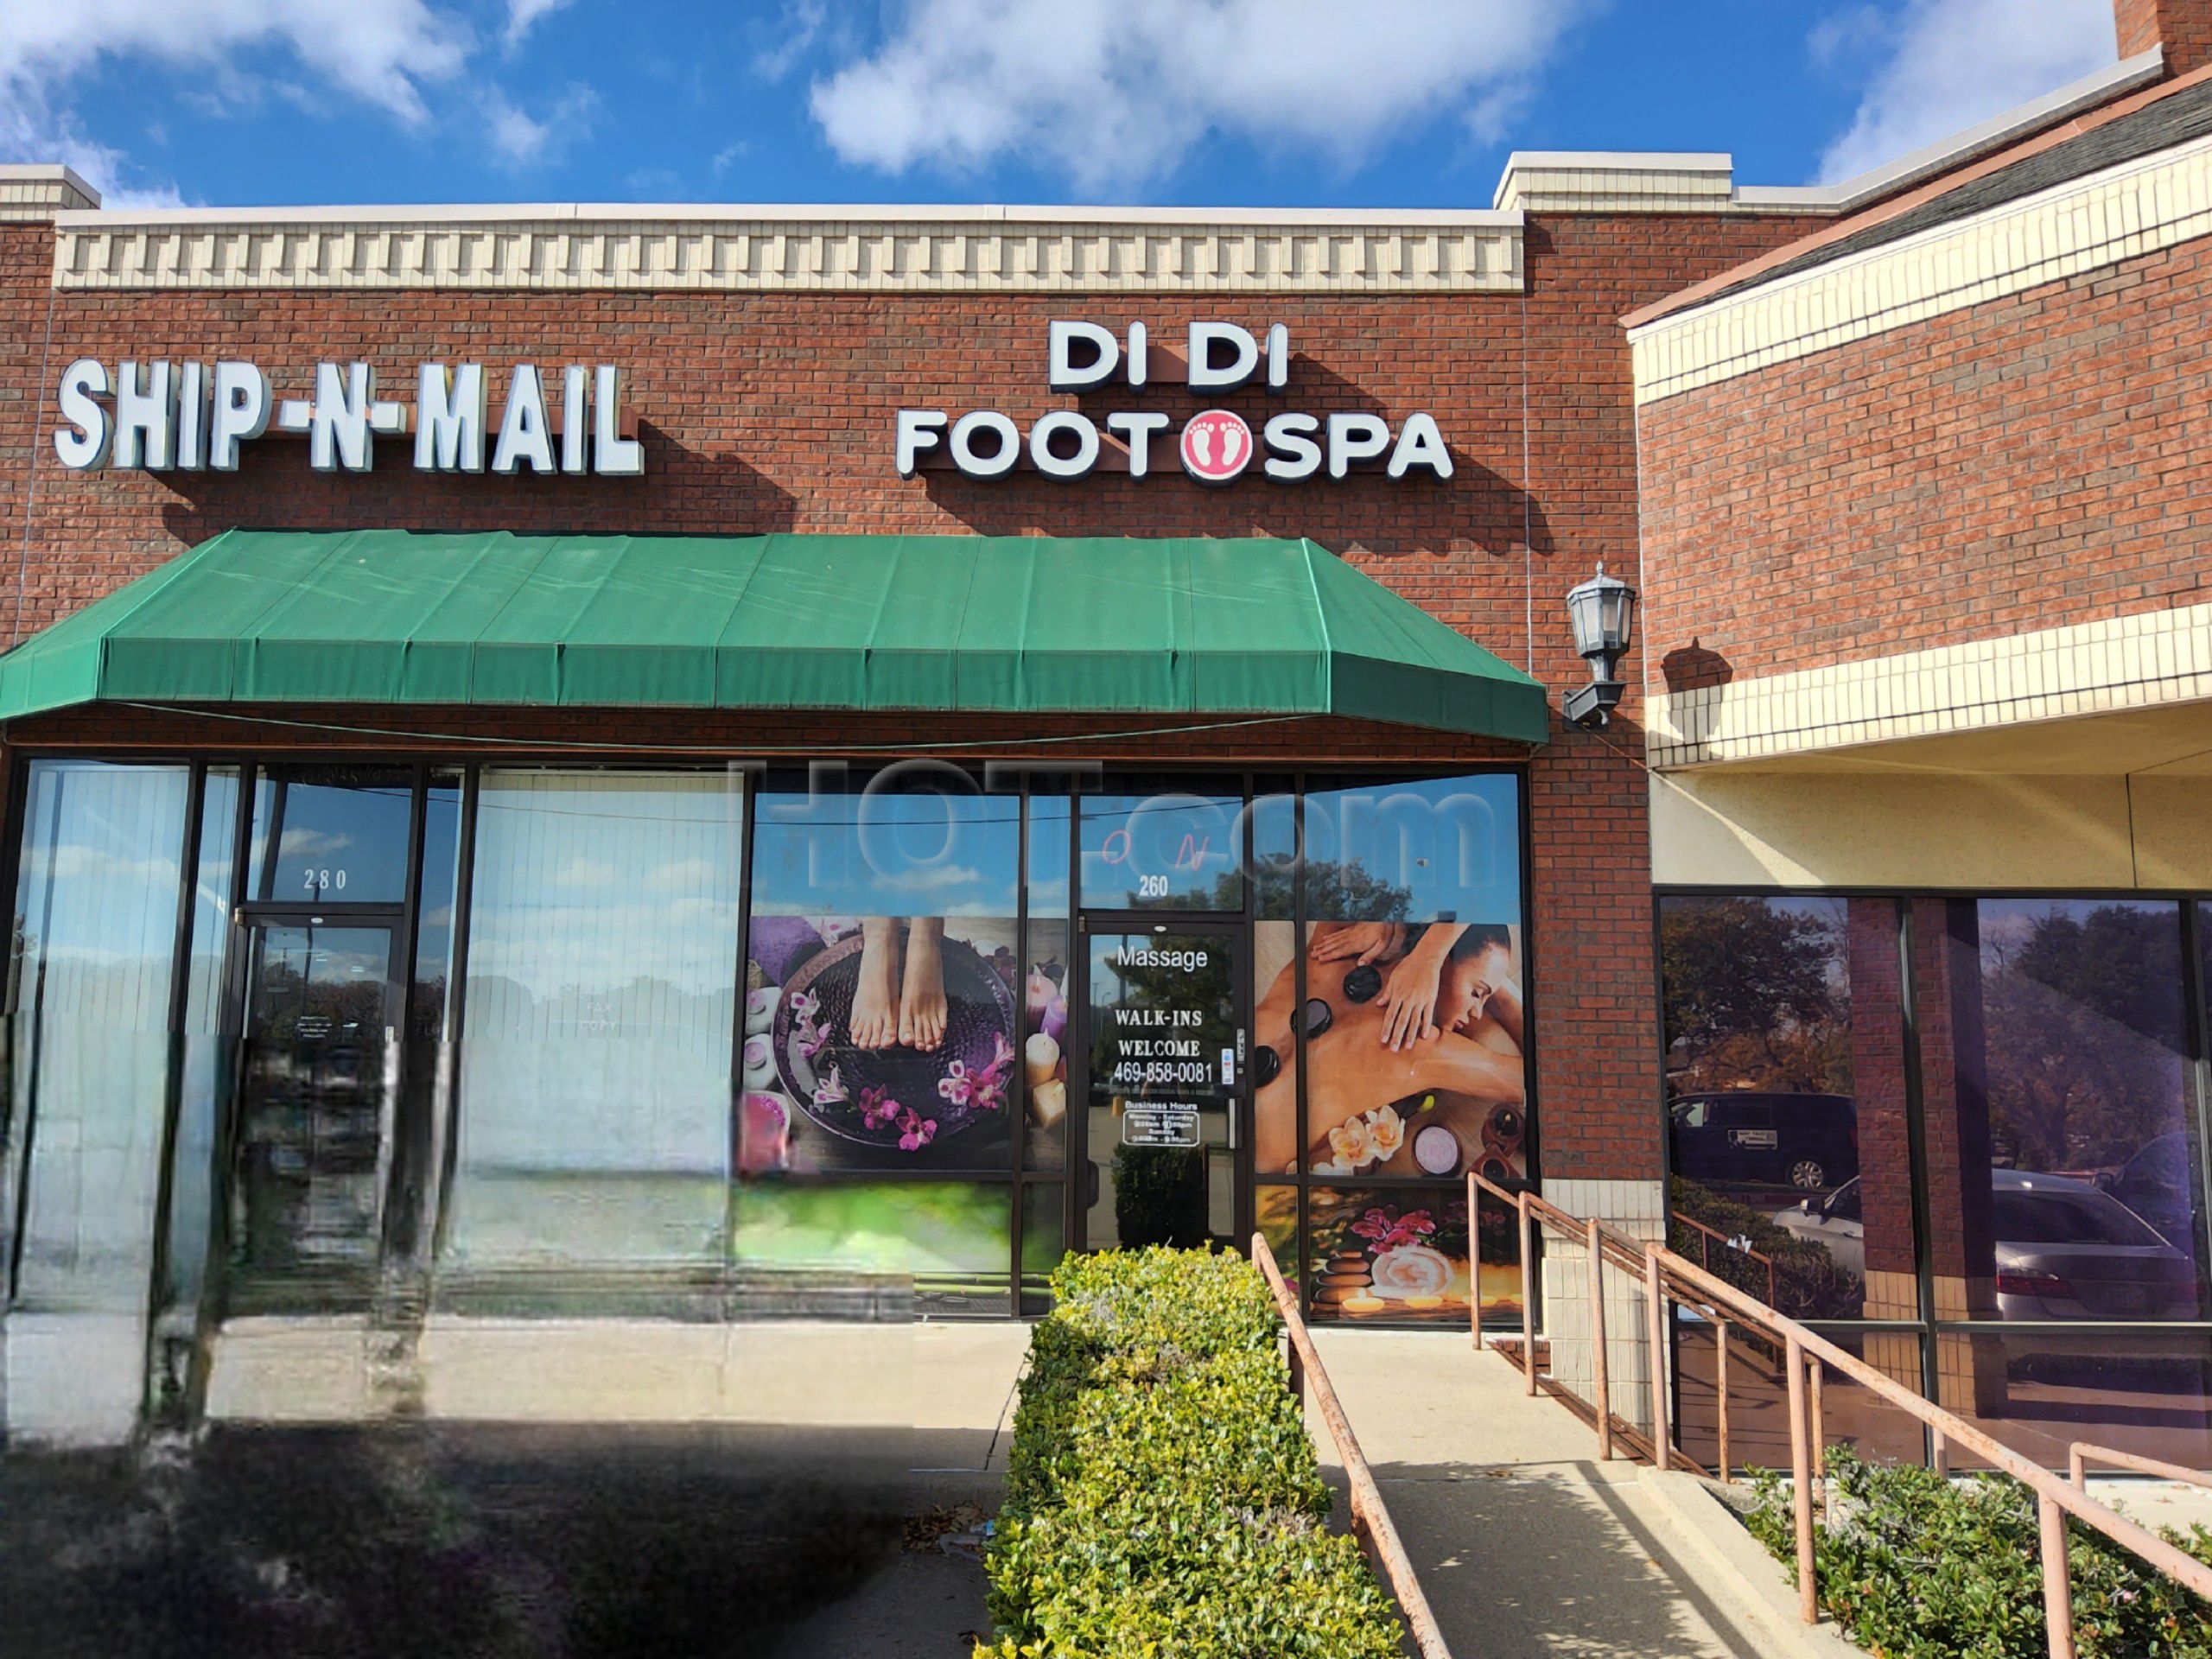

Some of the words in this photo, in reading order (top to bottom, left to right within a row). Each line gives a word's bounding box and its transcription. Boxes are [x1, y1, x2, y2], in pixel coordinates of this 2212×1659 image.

[1050, 321, 1147, 391] DI
[1188, 321, 1287, 392] DI
[54, 359, 645, 475] SHIP-N-MAIL
[896, 410, 1169, 481] FOOT
[1263, 412, 1454, 483] SPA
[303, 868, 346, 890] 280
[1139, 874, 1169, 897] 260
[1116, 944, 1208, 972] Massage
[1116, 1009, 1203, 1027] WALK-INS
[1117, 1039, 1201, 1057] WELCOME
[1113, 1061, 1212, 1083] 469-858-0081
[1125, 1100, 1167, 1109] Business
[1170, 1102, 1198, 1110] Hours
